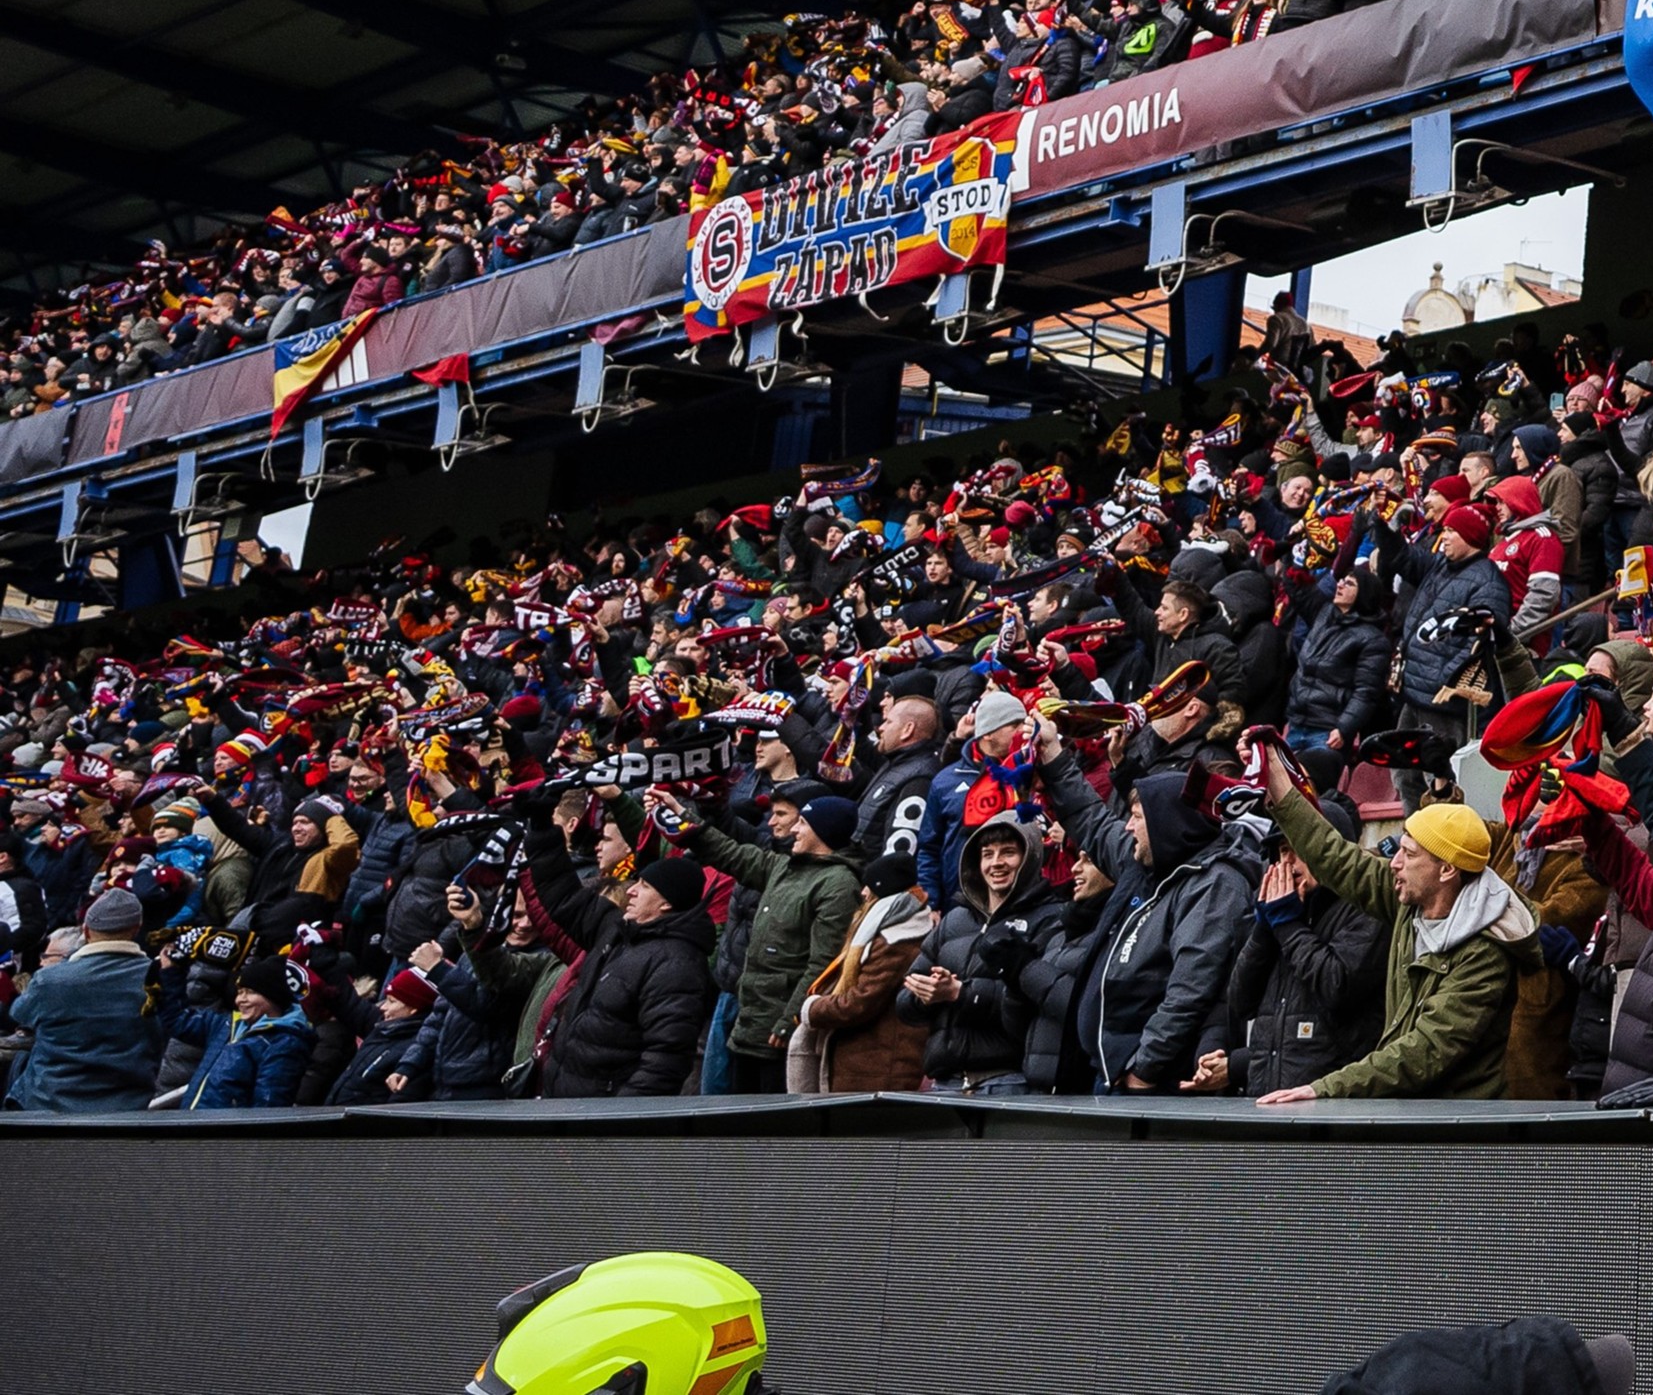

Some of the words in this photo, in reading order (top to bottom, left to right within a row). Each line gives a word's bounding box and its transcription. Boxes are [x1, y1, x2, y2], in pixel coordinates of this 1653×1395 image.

[1037, 89, 1182, 163] RENOMIA
[937, 184, 991, 217] STOD
[709, 215, 737, 285] S
[951, 226, 975, 241] 2014
[768, 225, 898, 310] ZÁPAD
[584, 732, 733, 787] SPART
[1380, 837, 1396, 857] FIL
